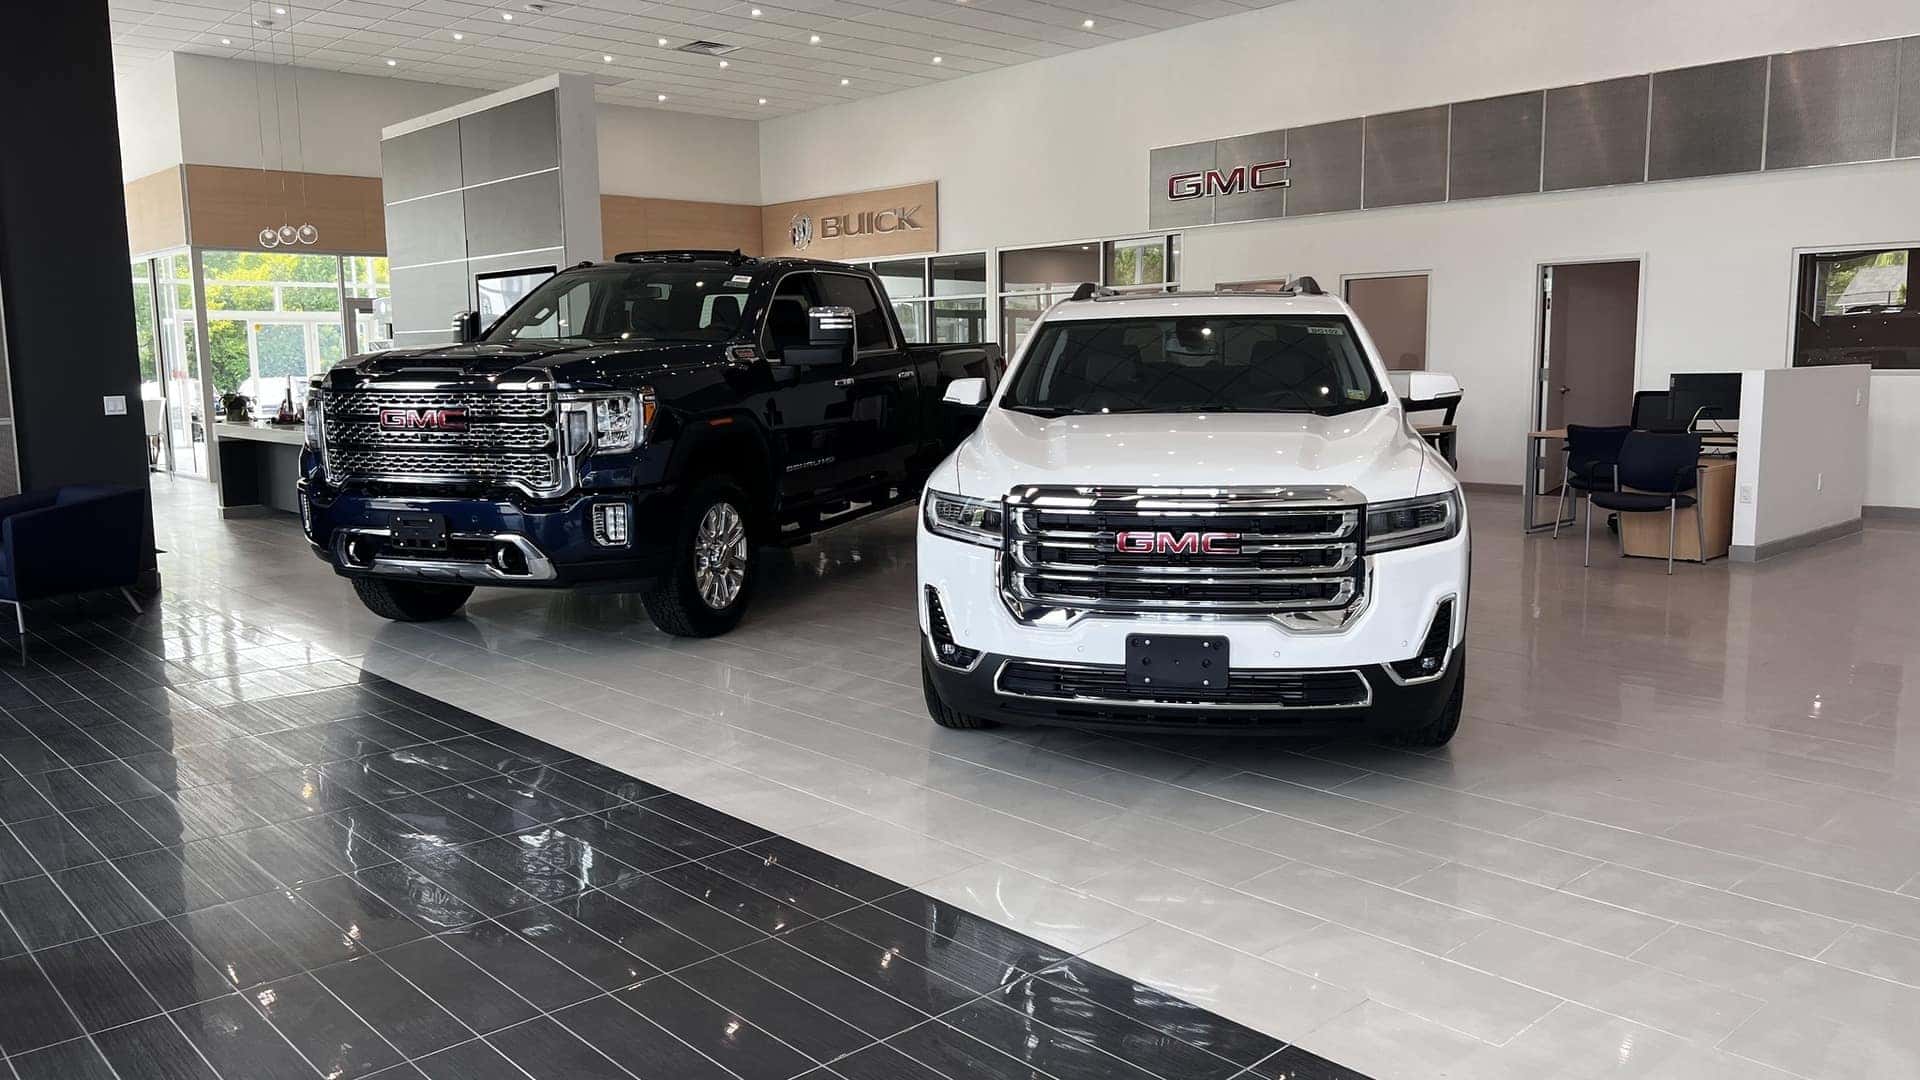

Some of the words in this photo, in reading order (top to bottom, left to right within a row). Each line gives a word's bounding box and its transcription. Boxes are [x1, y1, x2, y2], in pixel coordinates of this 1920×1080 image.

[1168, 159, 1291, 201] GMC
[820, 206, 923, 240] BUICK
[380, 409, 467, 429] GMC
[1116, 532, 1240, 554] GMC
